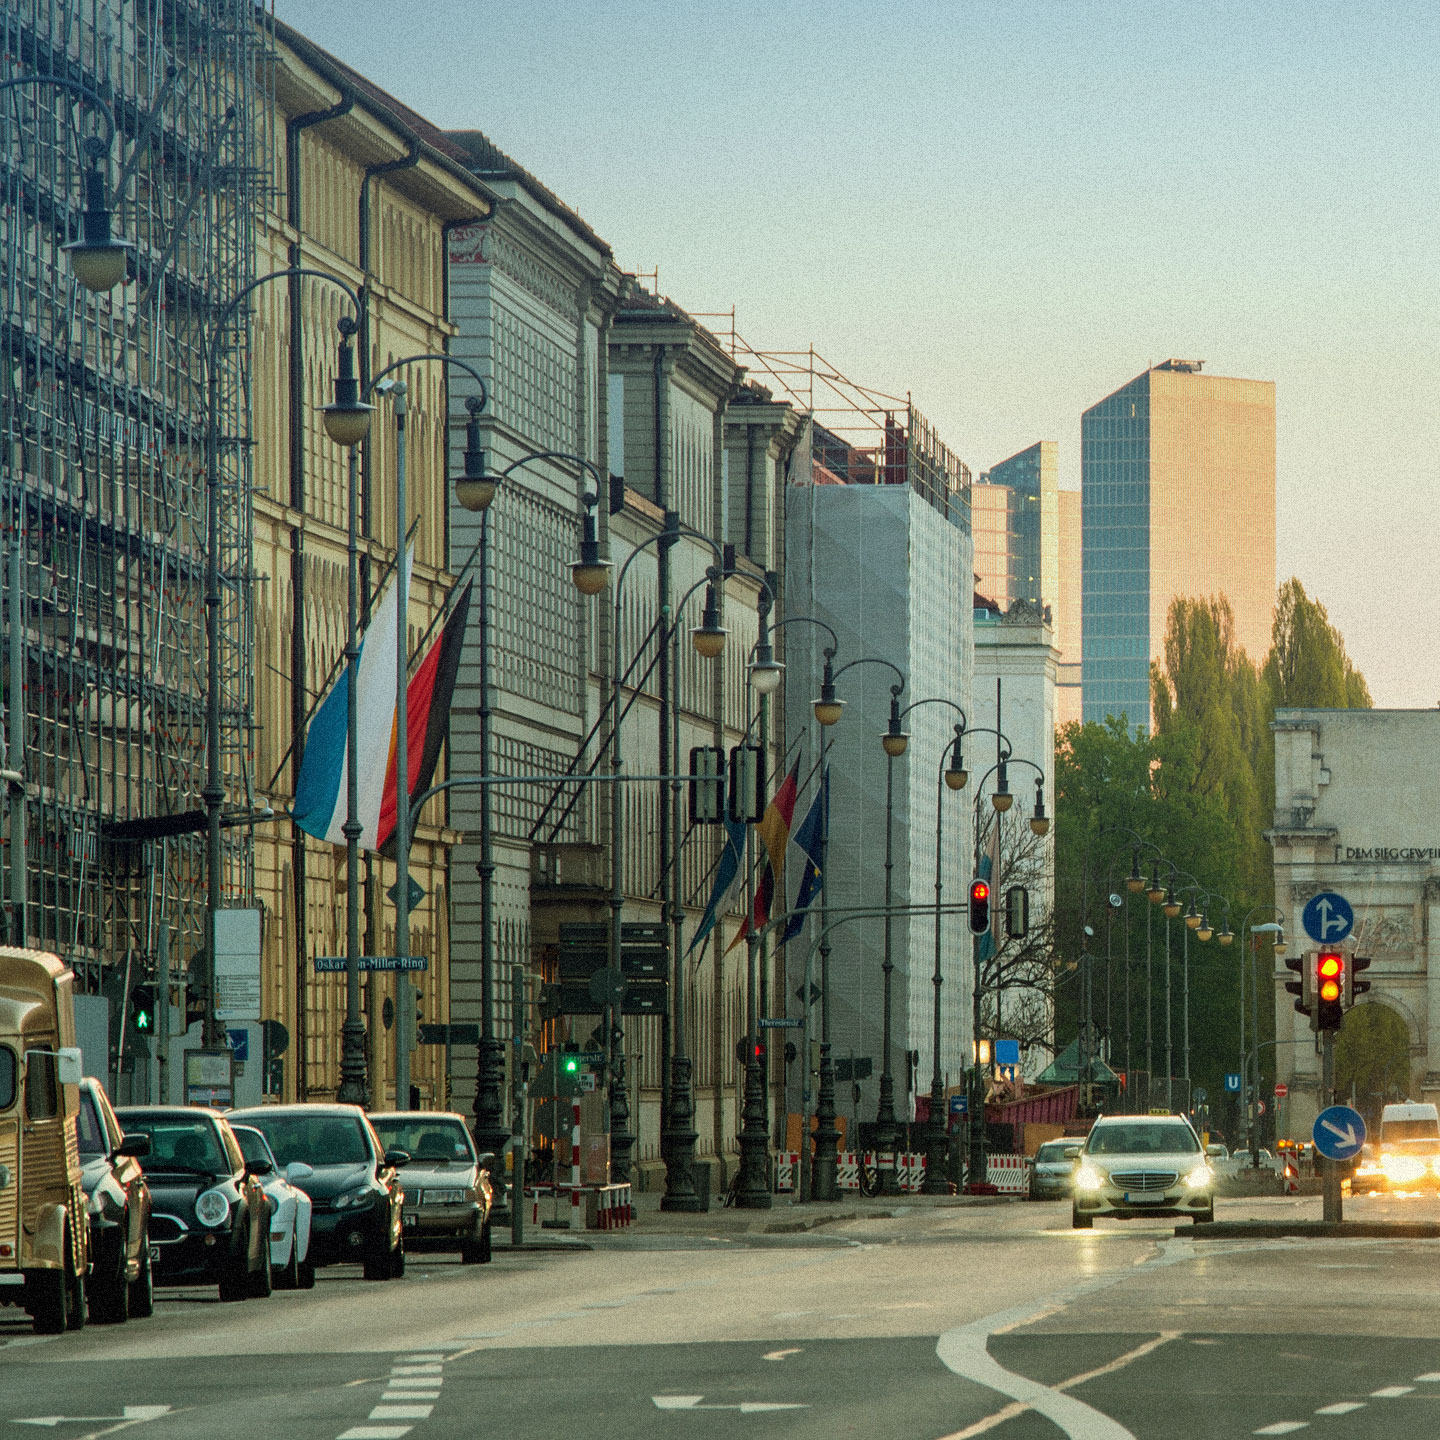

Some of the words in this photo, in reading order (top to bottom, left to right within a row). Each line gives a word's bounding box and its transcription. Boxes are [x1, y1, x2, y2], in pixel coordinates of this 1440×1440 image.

[1346, 847, 1372, 858] DEM
[1375, 848, 1399, 859] SIEG
[317, 957, 424, 970] Oskar-n-Miller-Ring
[1228, 1075, 1239, 1089] U
